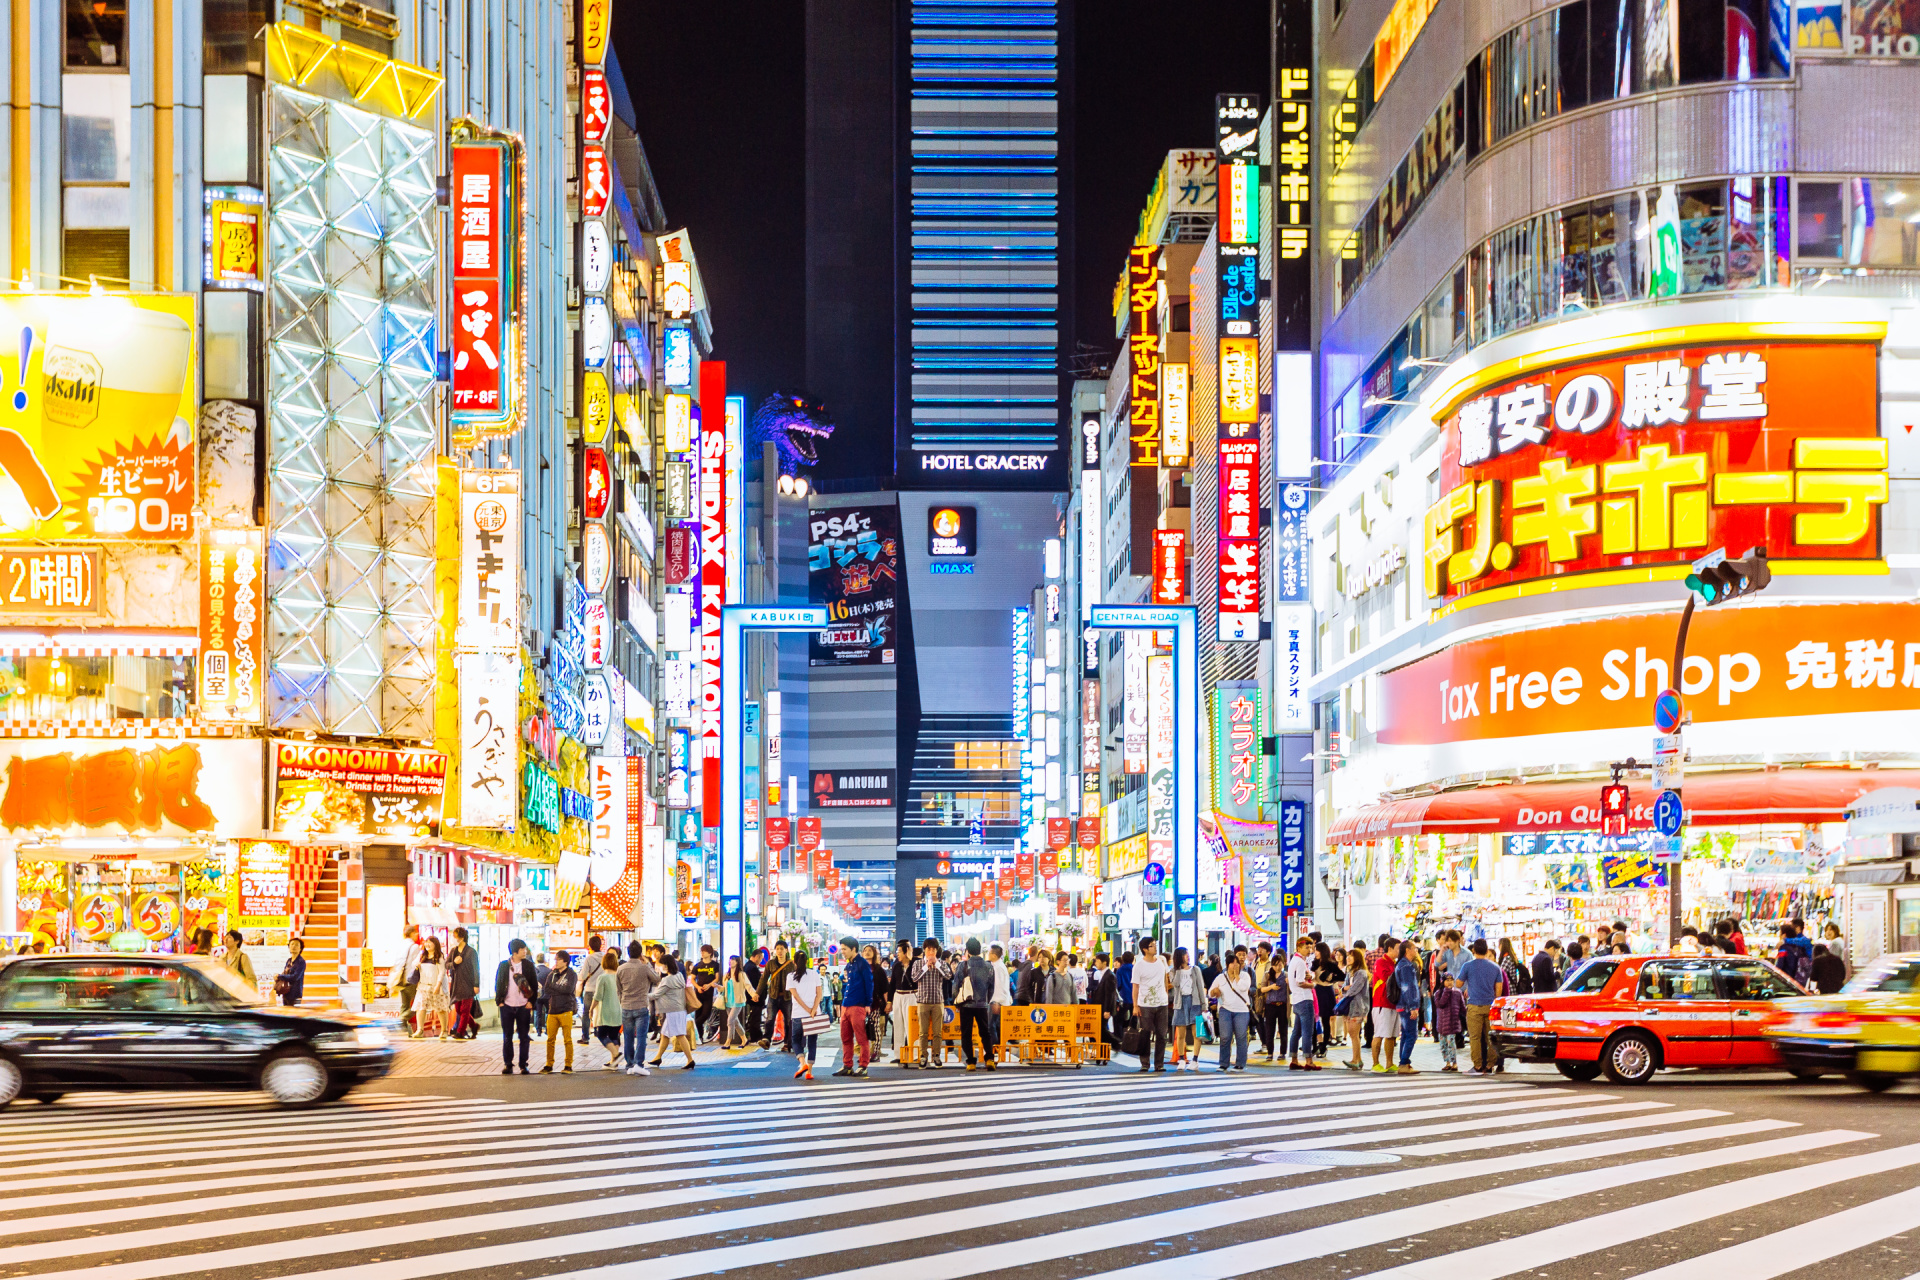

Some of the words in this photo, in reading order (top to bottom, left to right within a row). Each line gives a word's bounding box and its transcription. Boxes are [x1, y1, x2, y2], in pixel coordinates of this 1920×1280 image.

[461, 174, 490, 269] 居酒屋
[455, 290, 498, 369] つぼ八
[46, 373, 95, 404] Asahi
[1229, 423, 1250, 437] 6F
[116, 455, 178, 468] スーパードライ
[922, 455, 973, 470] HOTEL
[975, 455, 1048, 470] GRACERY
[98, 466, 187, 496] 生ビール
[477, 475, 506, 493] 6F
[701, 430, 724, 567] SHIDAX
[1228, 469, 1250, 537] 居楽屋
[671, 531, 684, 579] 焼肉屋さかい
[930, 563, 973, 574] IMAX
[209, 549, 226, 650] 夜景の見える
[1097, 613, 1146, 621] CENTRAL
[1150, 613, 1180, 621] ROAD
[206, 654, 227, 697] 個室
[702, 585, 721, 758] KARAOKE
[1289, 629, 1300, 698] 写真スタジオ
[1439, 679, 1480, 725] Tax
[1489, 665, 1584, 714] Free
[1600, 646, 1762, 705] Shop
[1158, 661, 1173, 744] きんくら酒場
[280, 745, 388, 771] OKONOMI
[395, 753, 446, 774] YAKI
[470, 696, 505, 797] うさぎや
[1230, 696, 1256, 806] カラオケ
[280, 767, 346, 780] All-You-Can-Eat
[347, 773, 373, 781] dinner
[375, 774, 392, 782] with
[393, 775, 443, 786] Free-Flowing
[345, 782, 372, 791] Drinks
[373, 783, 385, 791] for
[386, 784, 392, 792] 2
[393, 784, 416, 793] hours
[417, 785, 443, 795] ¥2,700
[839, 775, 888, 789] MARUHAN
[596, 765, 612, 840] トラノコ
[1517, 808, 1562, 825] Don
[1570, 805, 1655, 824] Quote
[1659, 802, 1671, 830] P
[1283, 806, 1302, 889] カラオケ
[1510, 835, 1535, 855] 3F
[1253, 854, 1271, 924] カラオケ
[1283, 893, 1301, 906] B1
[1012, 1025, 1065, 1034] 歩行者専用
